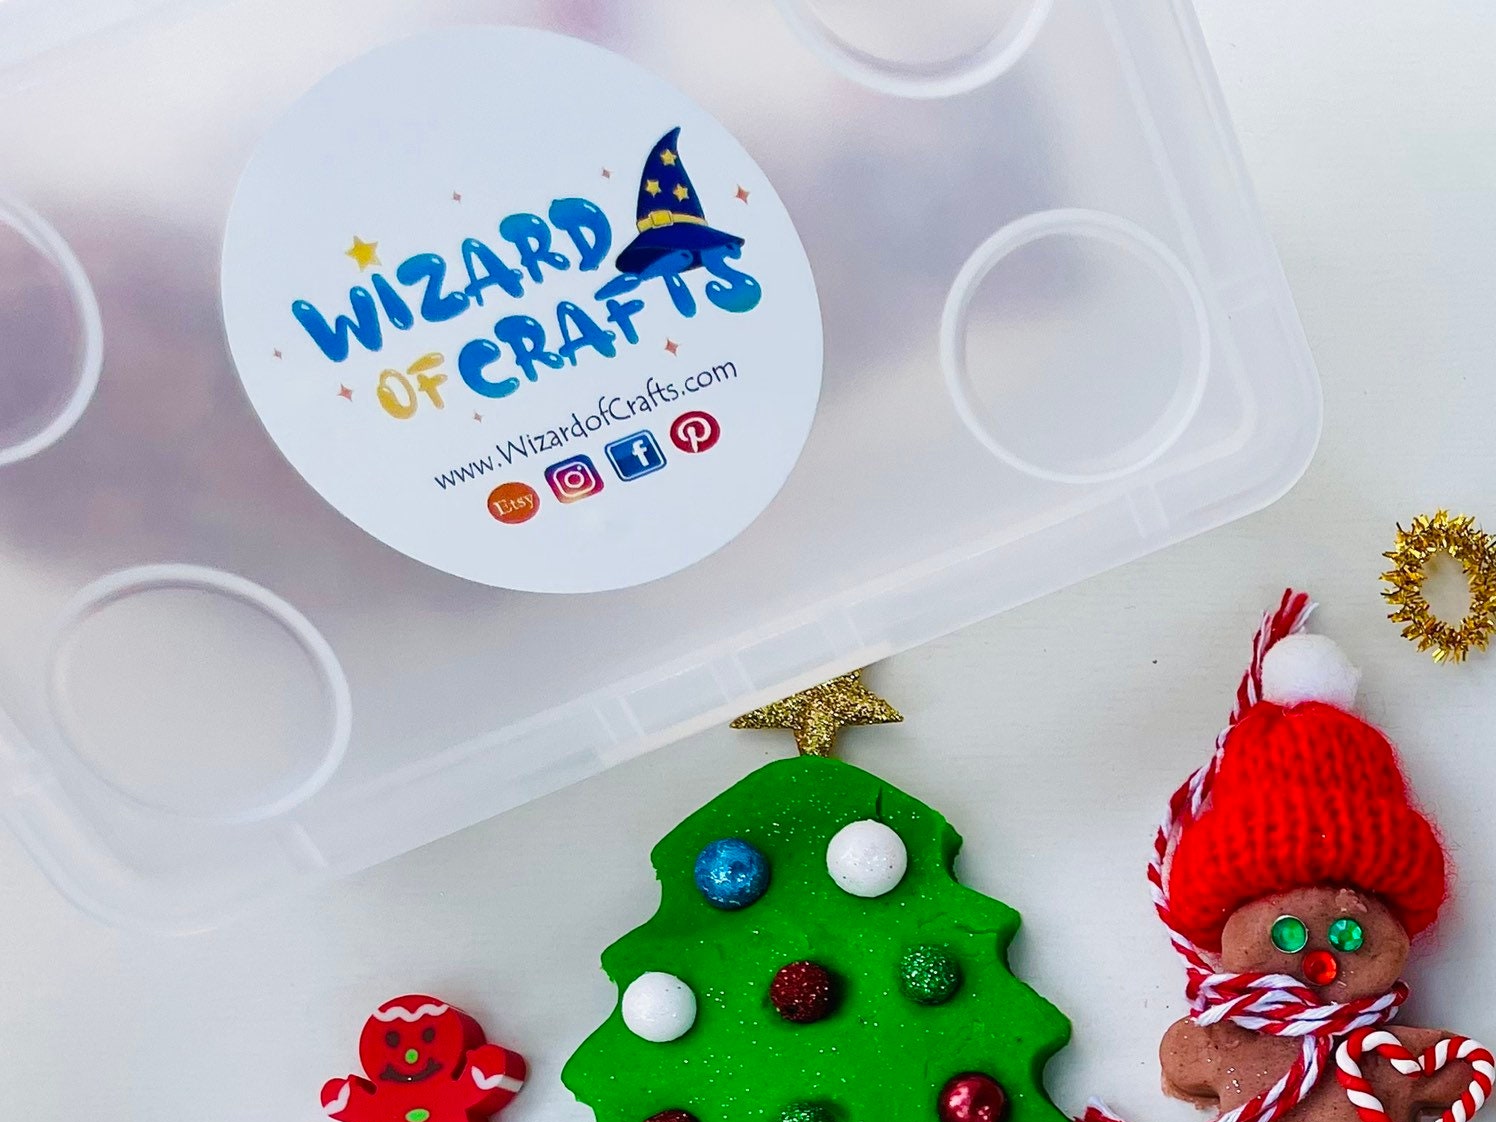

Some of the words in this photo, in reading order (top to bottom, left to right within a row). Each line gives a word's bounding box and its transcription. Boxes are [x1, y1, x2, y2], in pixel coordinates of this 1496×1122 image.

[292, 197, 612, 363] WIZARD
[376, 352, 448, 420] OF
[458, 239, 762, 399] CRAFTS
[434, 360, 738, 490] www.WizardofCrafts.com
[493, 493, 536, 516] Etsy
